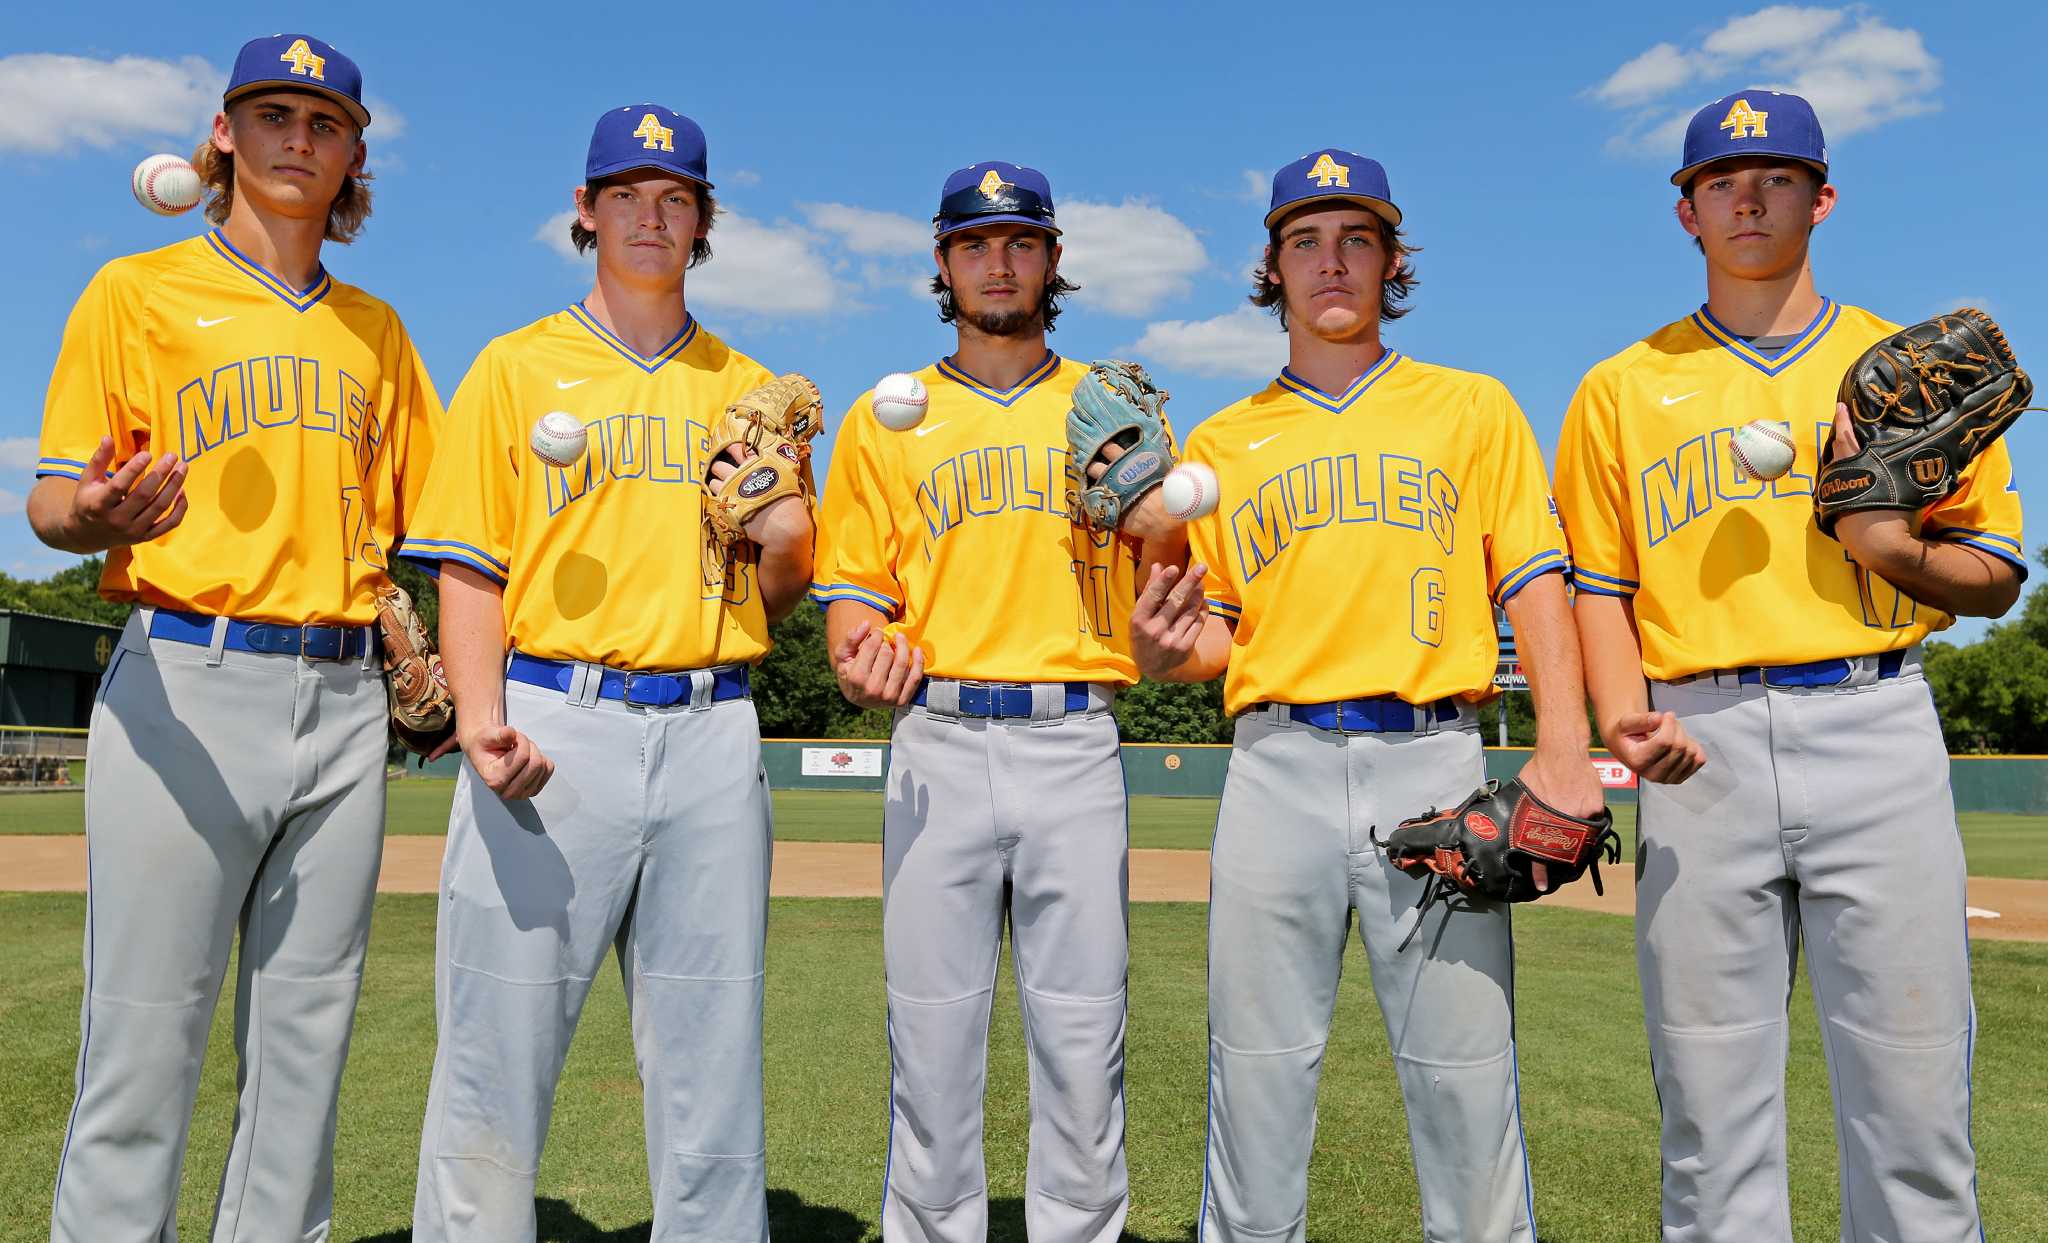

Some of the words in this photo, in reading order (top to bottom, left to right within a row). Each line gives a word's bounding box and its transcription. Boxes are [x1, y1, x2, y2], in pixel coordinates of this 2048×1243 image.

[280, 38, 326, 81] AH
[633, 113, 675, 152] AH
[1720, 98, 1768, 140] AH
[1306, 153, 1350, 188] AH
[545, 414, 710, 517] MULE
[743, 471, 775, 495] Slugger
[1641, 421, 1833, 548] MUL
[1911, 456, 1944, 482] W
[916, 444, 1110, 563] MULE
[1231, 453, 1459, 584] MULES
[1410, 567, 1446, 648] 6
[1492, 674, 1528, 684] OADWA
